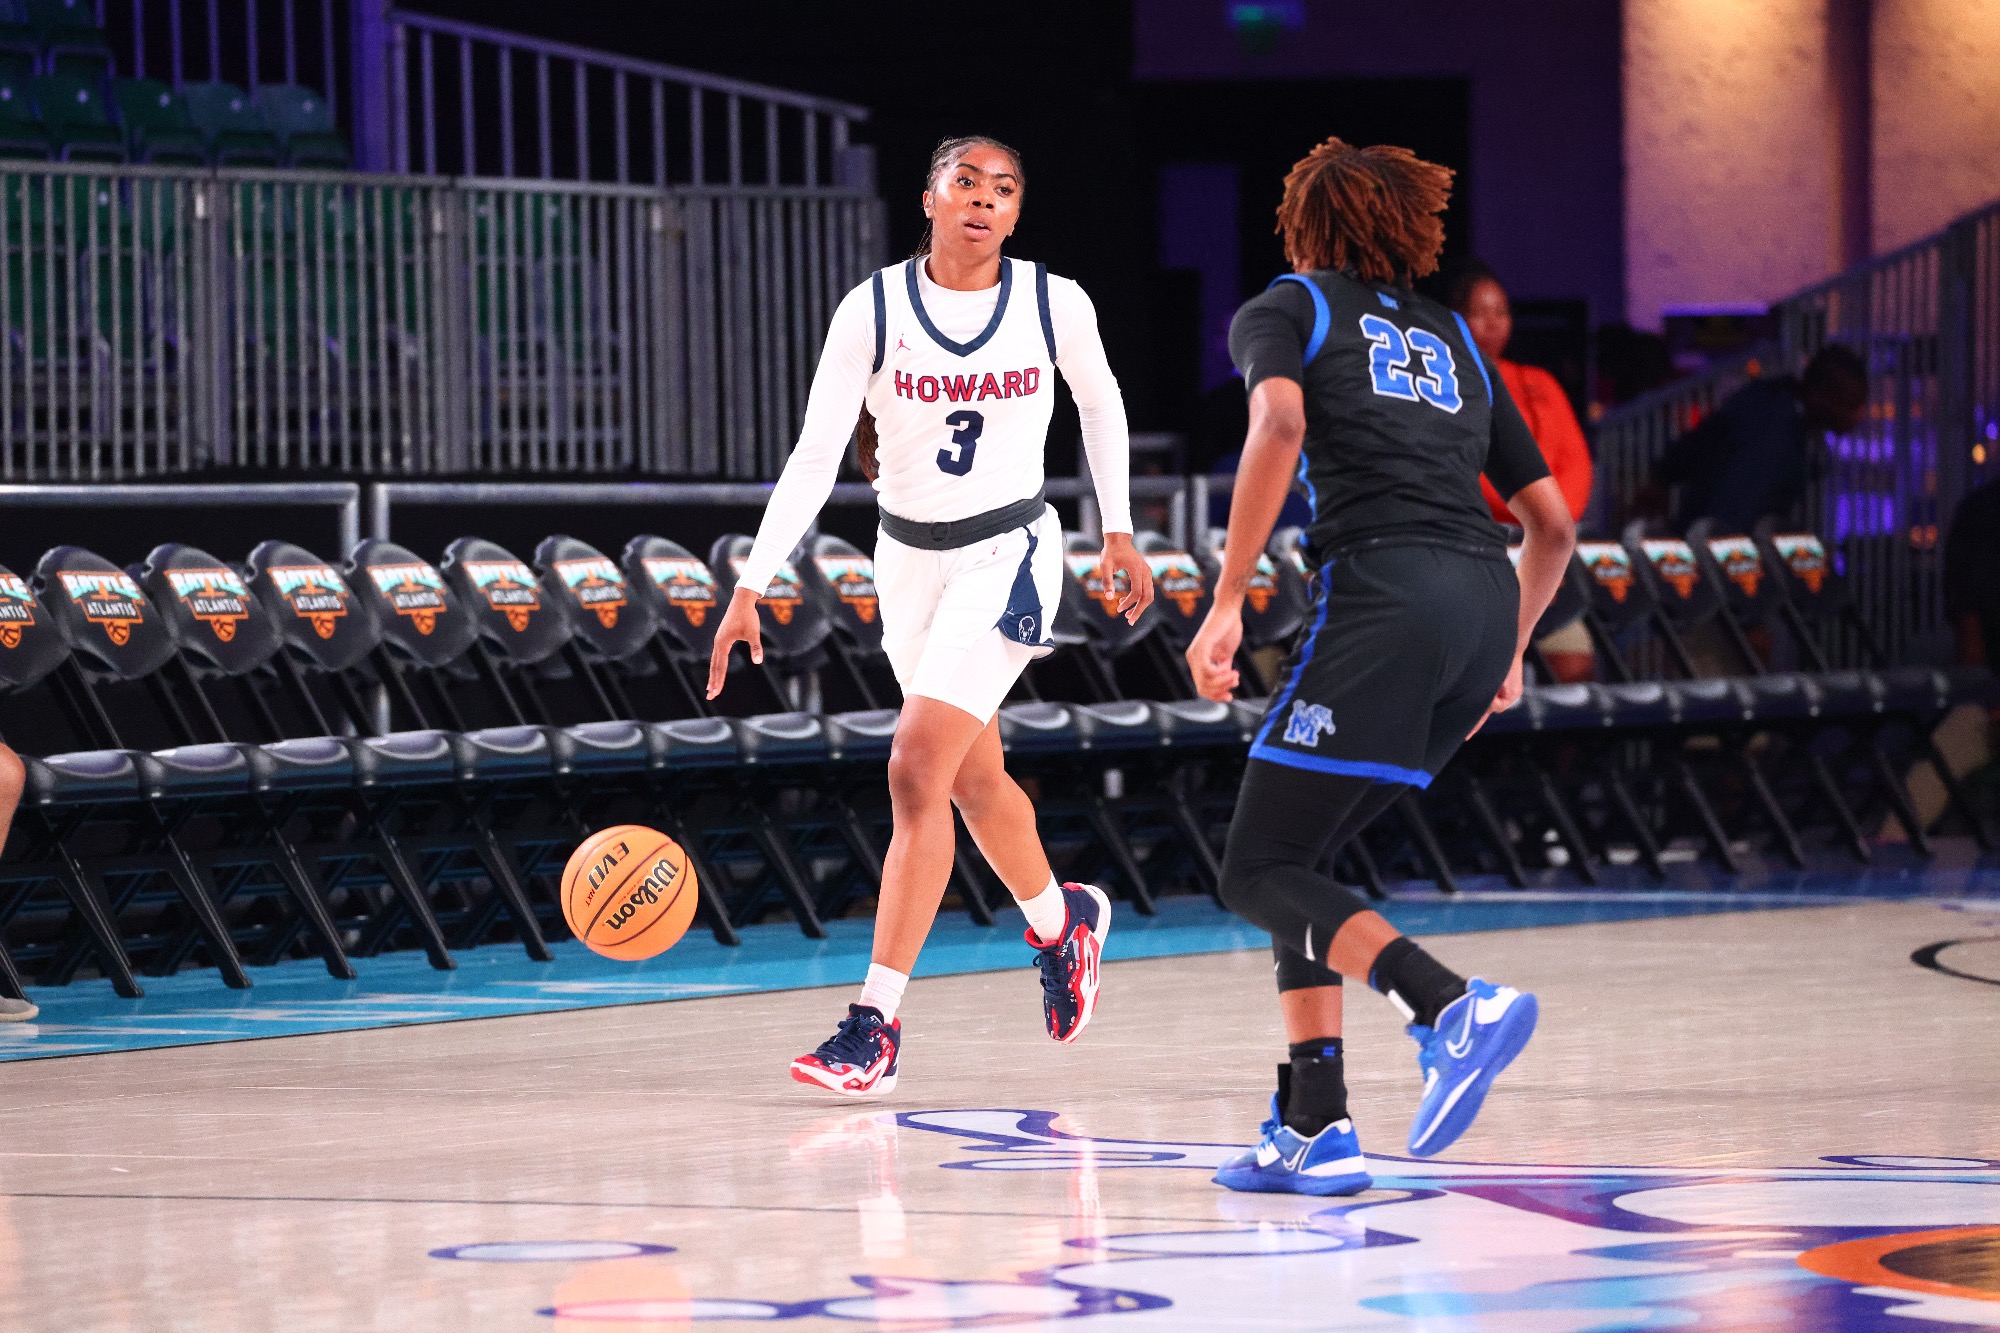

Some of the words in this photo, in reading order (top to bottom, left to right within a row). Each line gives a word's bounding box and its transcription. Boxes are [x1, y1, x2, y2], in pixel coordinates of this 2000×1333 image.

[894, 367, 1040, 403] HOWARD
[1359, 313, 1463, 414] 23
[936, 410, 984, 477] 3
[87, 601, 137, 617] ATLANTIS
[588, 841, 630, 890] EVO
[585, 888, 596, 907] NXT
[605, 858, 680, 930] Wilson
